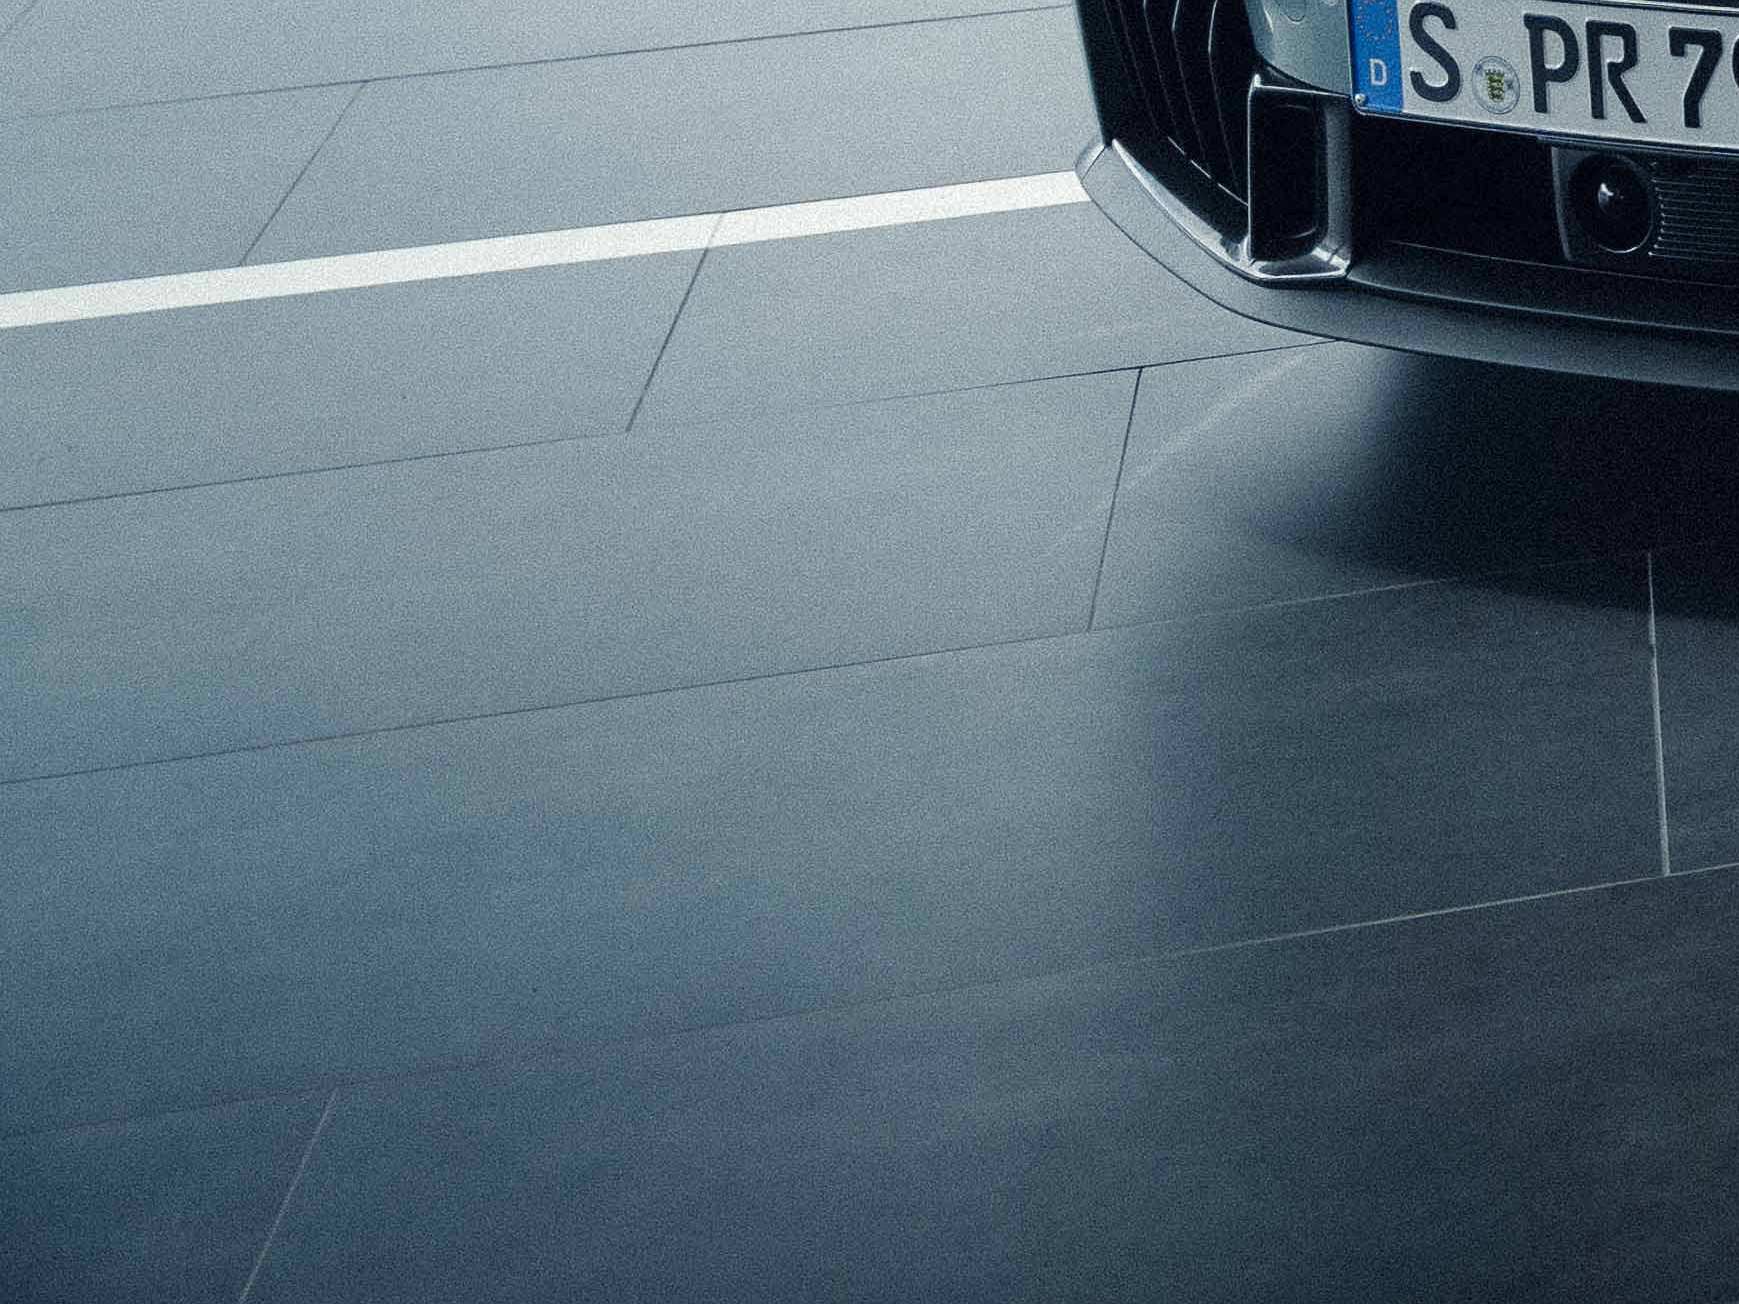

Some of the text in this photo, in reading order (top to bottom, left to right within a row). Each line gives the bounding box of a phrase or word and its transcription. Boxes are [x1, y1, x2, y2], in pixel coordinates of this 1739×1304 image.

[1369, 57, 1388, 87] D
[1409, 1, 1461, 103] S
[1523, 13, 1648, 124] PR
